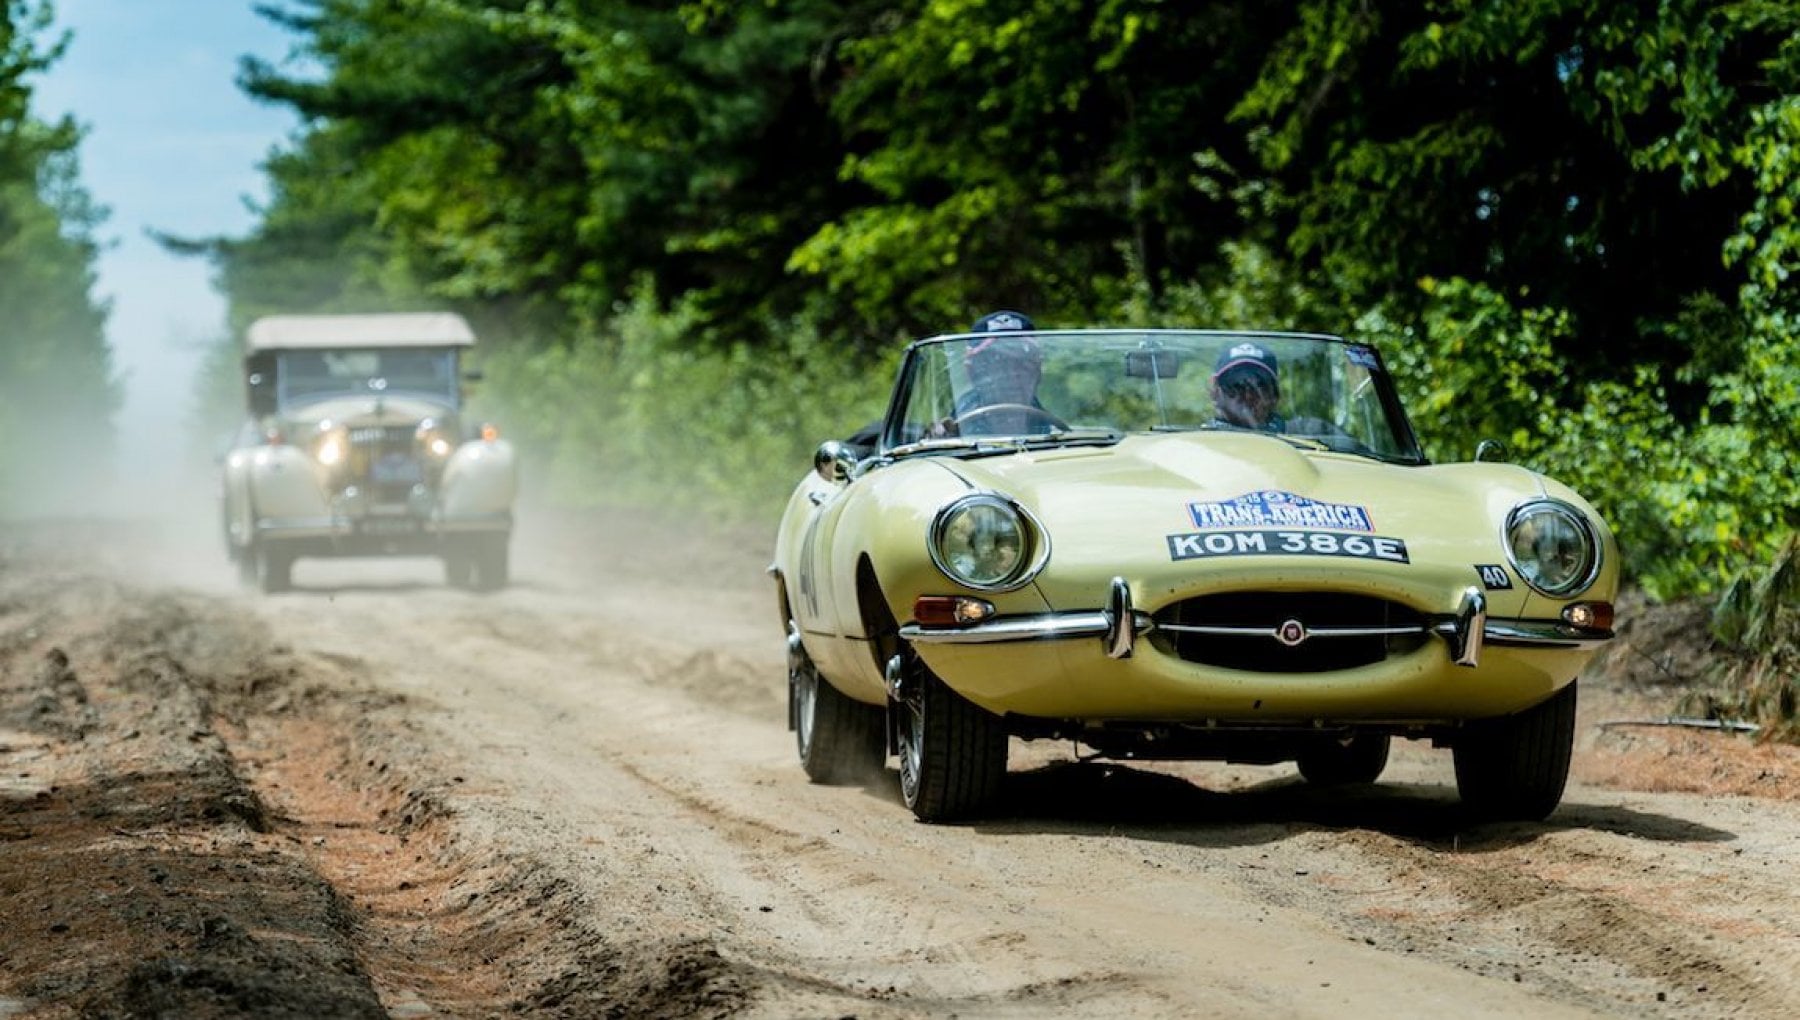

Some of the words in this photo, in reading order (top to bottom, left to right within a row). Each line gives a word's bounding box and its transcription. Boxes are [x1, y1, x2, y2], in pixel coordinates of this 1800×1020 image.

[1194, 502, 1366, 529] TRANS-AMERICA
[1173, 533, 1265, 556] KOM
[1277, 532, 1404, 560] 386E
[1483, 566, 1508, 586] 40
